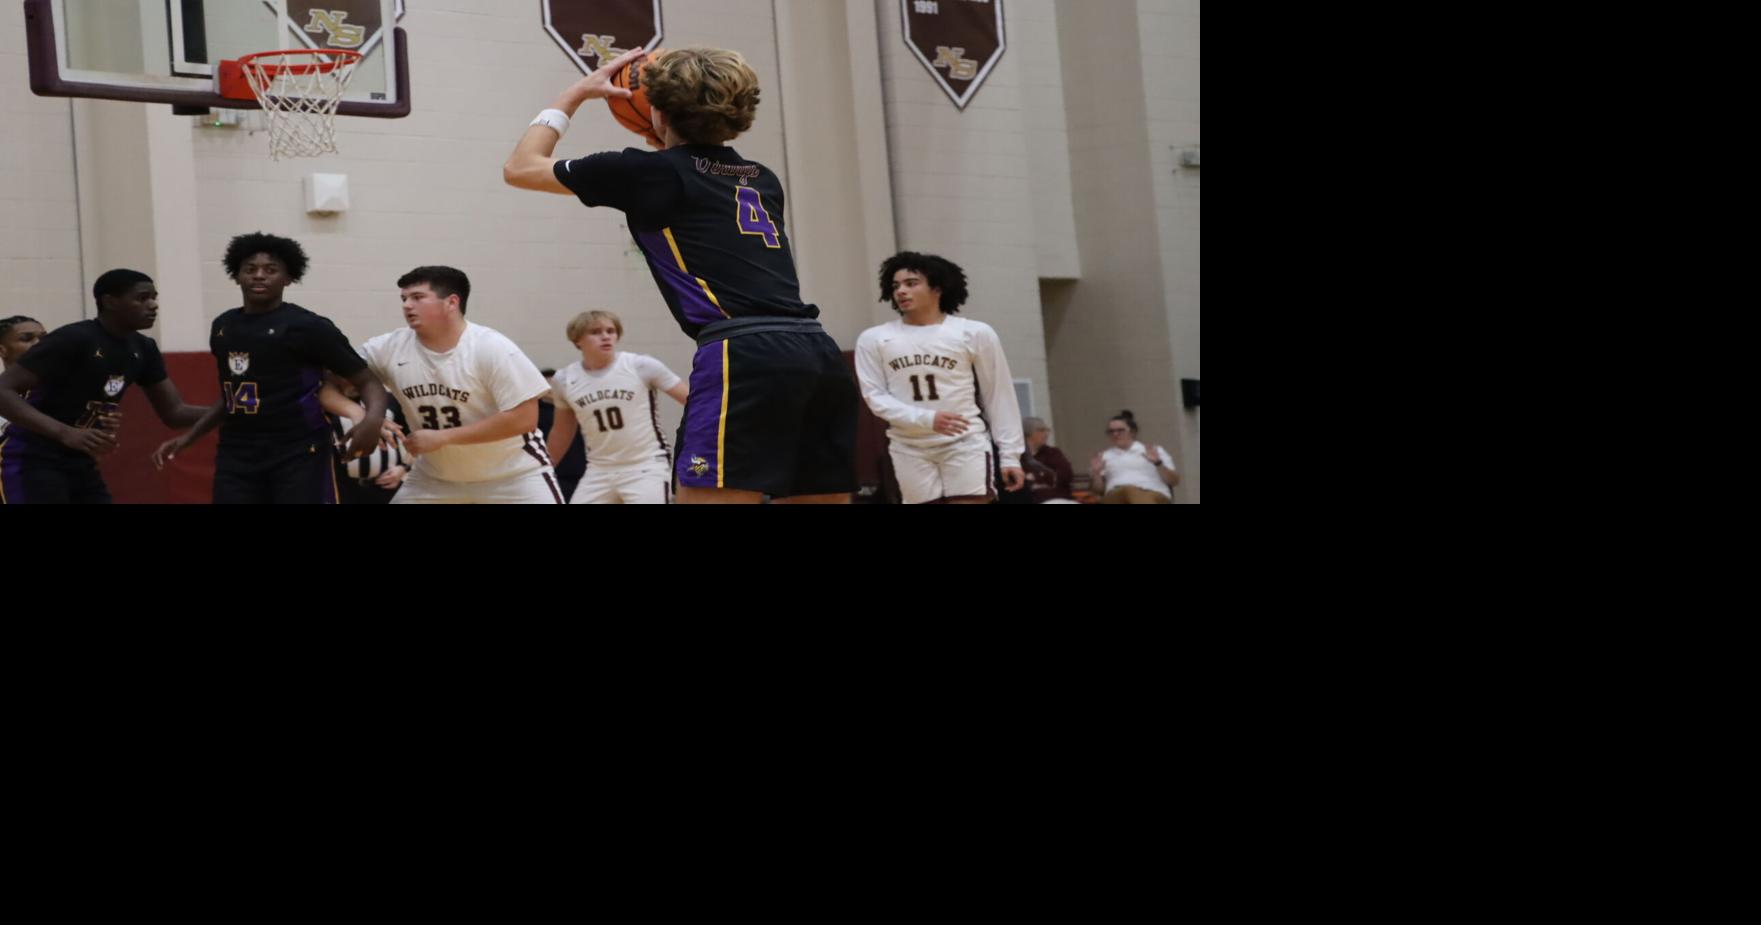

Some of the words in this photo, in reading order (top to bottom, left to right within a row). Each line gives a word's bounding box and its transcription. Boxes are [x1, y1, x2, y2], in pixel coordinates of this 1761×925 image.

[914, 1, 938, 14] 1991
[304, 8, 365, 48] NS
[932, 46, 978, 80] NS
[735, 185, 781, 248] 4
[888, 353, 958, 372] WILDCATS
[223, 381, 260, 414] 14
[402, 383, 470, 403] WILDCATS
[575, 389, 635, 408] WILDCATS
[909, 374, 940, 402] 11
[417, 405, 463, 431] 33
[593, 406, 625, 432] 10
